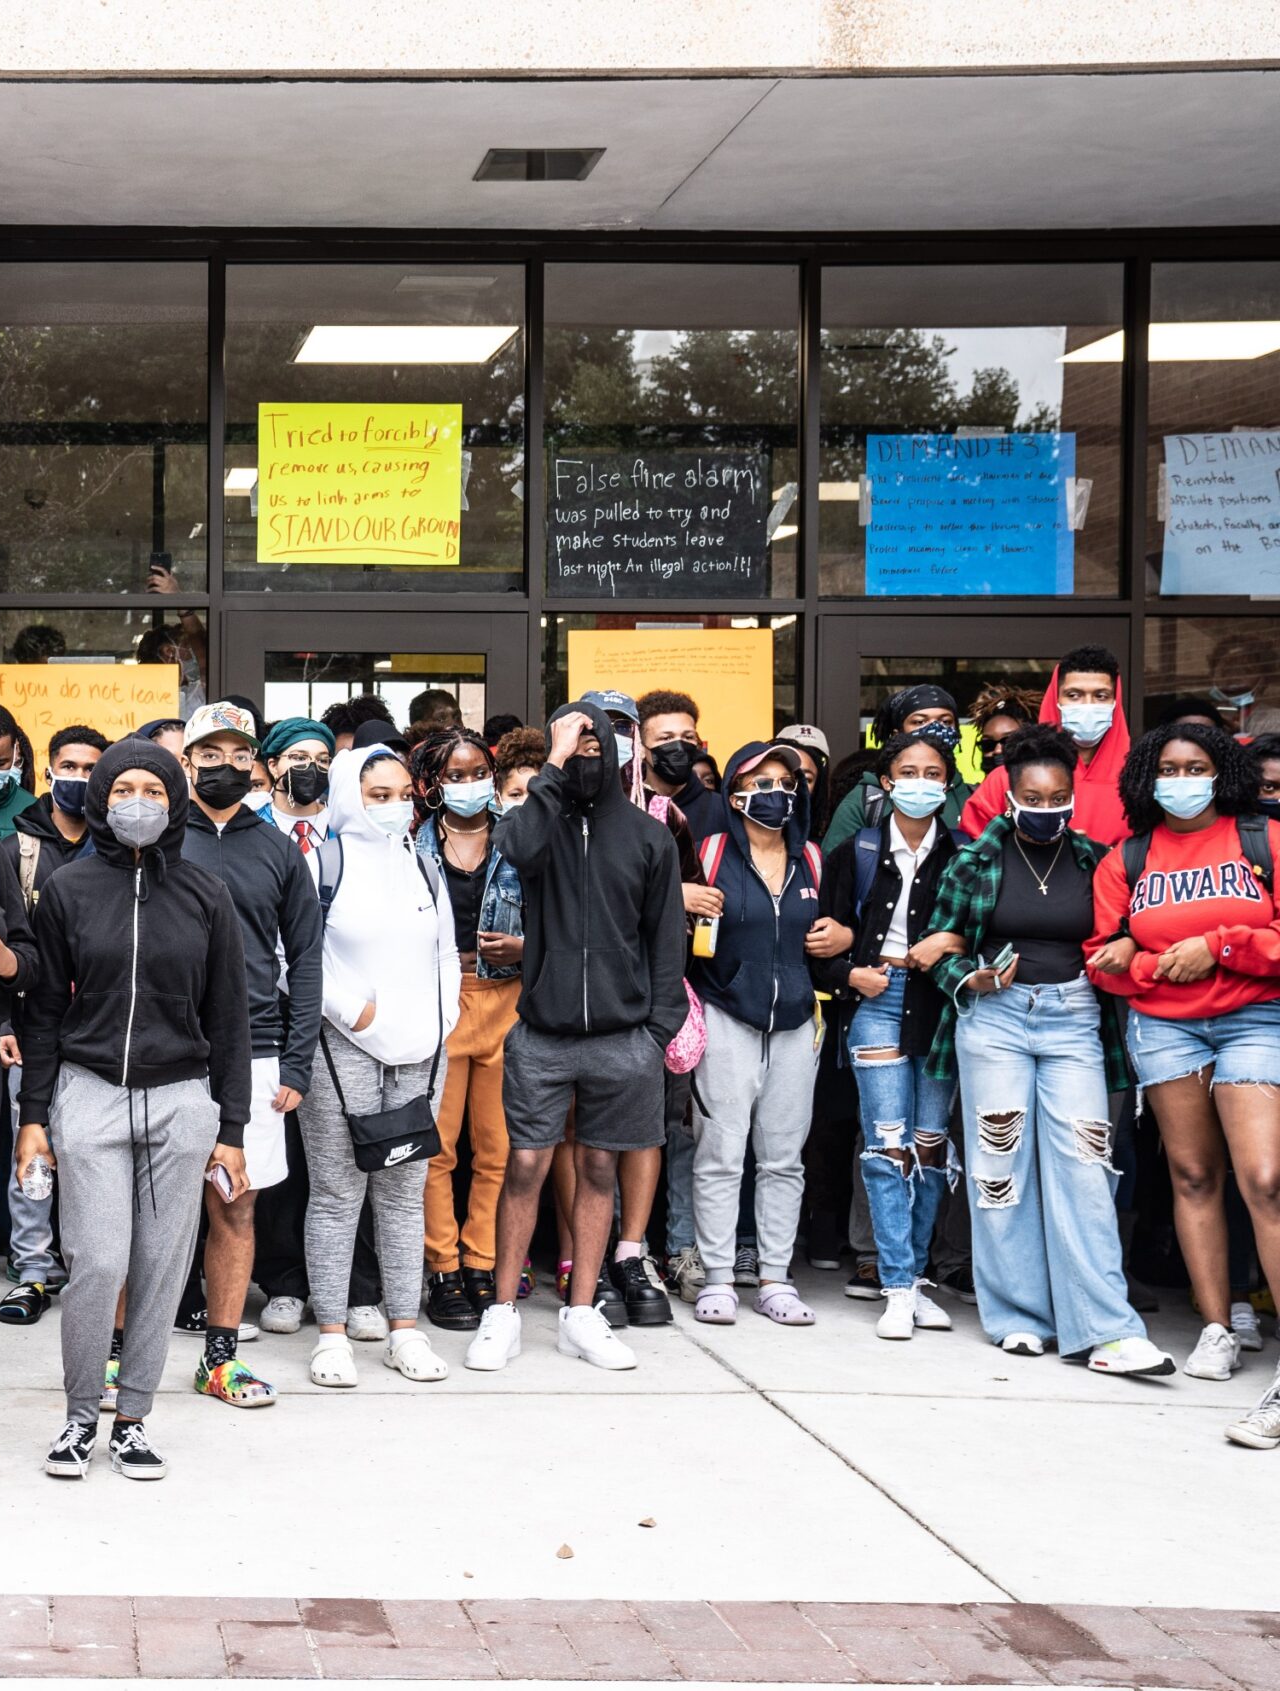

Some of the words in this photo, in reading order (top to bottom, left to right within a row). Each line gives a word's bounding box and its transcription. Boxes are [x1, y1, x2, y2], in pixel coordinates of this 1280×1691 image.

[264, 413, 333, 449] Tried
[339, 427, 358, 442] to
[363, 415, 439, 450] forcibly
[878, 436, 990, 463] DEMAND
[268, 459, 330, 480] remove
[362, 458, 431, 485] causing
[555, 459, 621, 500] False
[684, 458, 755, 499] alarm
[1172, 470, 1236, 488] Reinstate
[269, 493, 288, 508] us
[296, 492, 312, 507] to
[353, 488, 391, 506] arms
[400, 487, 422, 499] to
[1219, 491, 1272, 510] positions
[555, 507, 588, 523] was
[593, 499, 640, 529] pulled
[646, 506, 663, 519] to
[667, 506, 693, 528] try
[700, 499, 732, 520] and
[555, 530, 605, 554] make
[685, 530, 725, 547] leave
[1195, 544, 1213, 555] on
[1221, 539, 1244, 554] the
[558, 558, 584, 577] last
[587, 560, 621, 586] night
[625, 557, 643, 573] An
[650, 557, 684, 579] illegal
[14, 678, 49, 708] you
[59, 676, 82, 699] do
[88, 679, 126, 705] not
[130, 683, 174, 706] leave
[1128, 860, 1263, 917] HOWARD
[389, 1142, 414, 1160] NIKE
